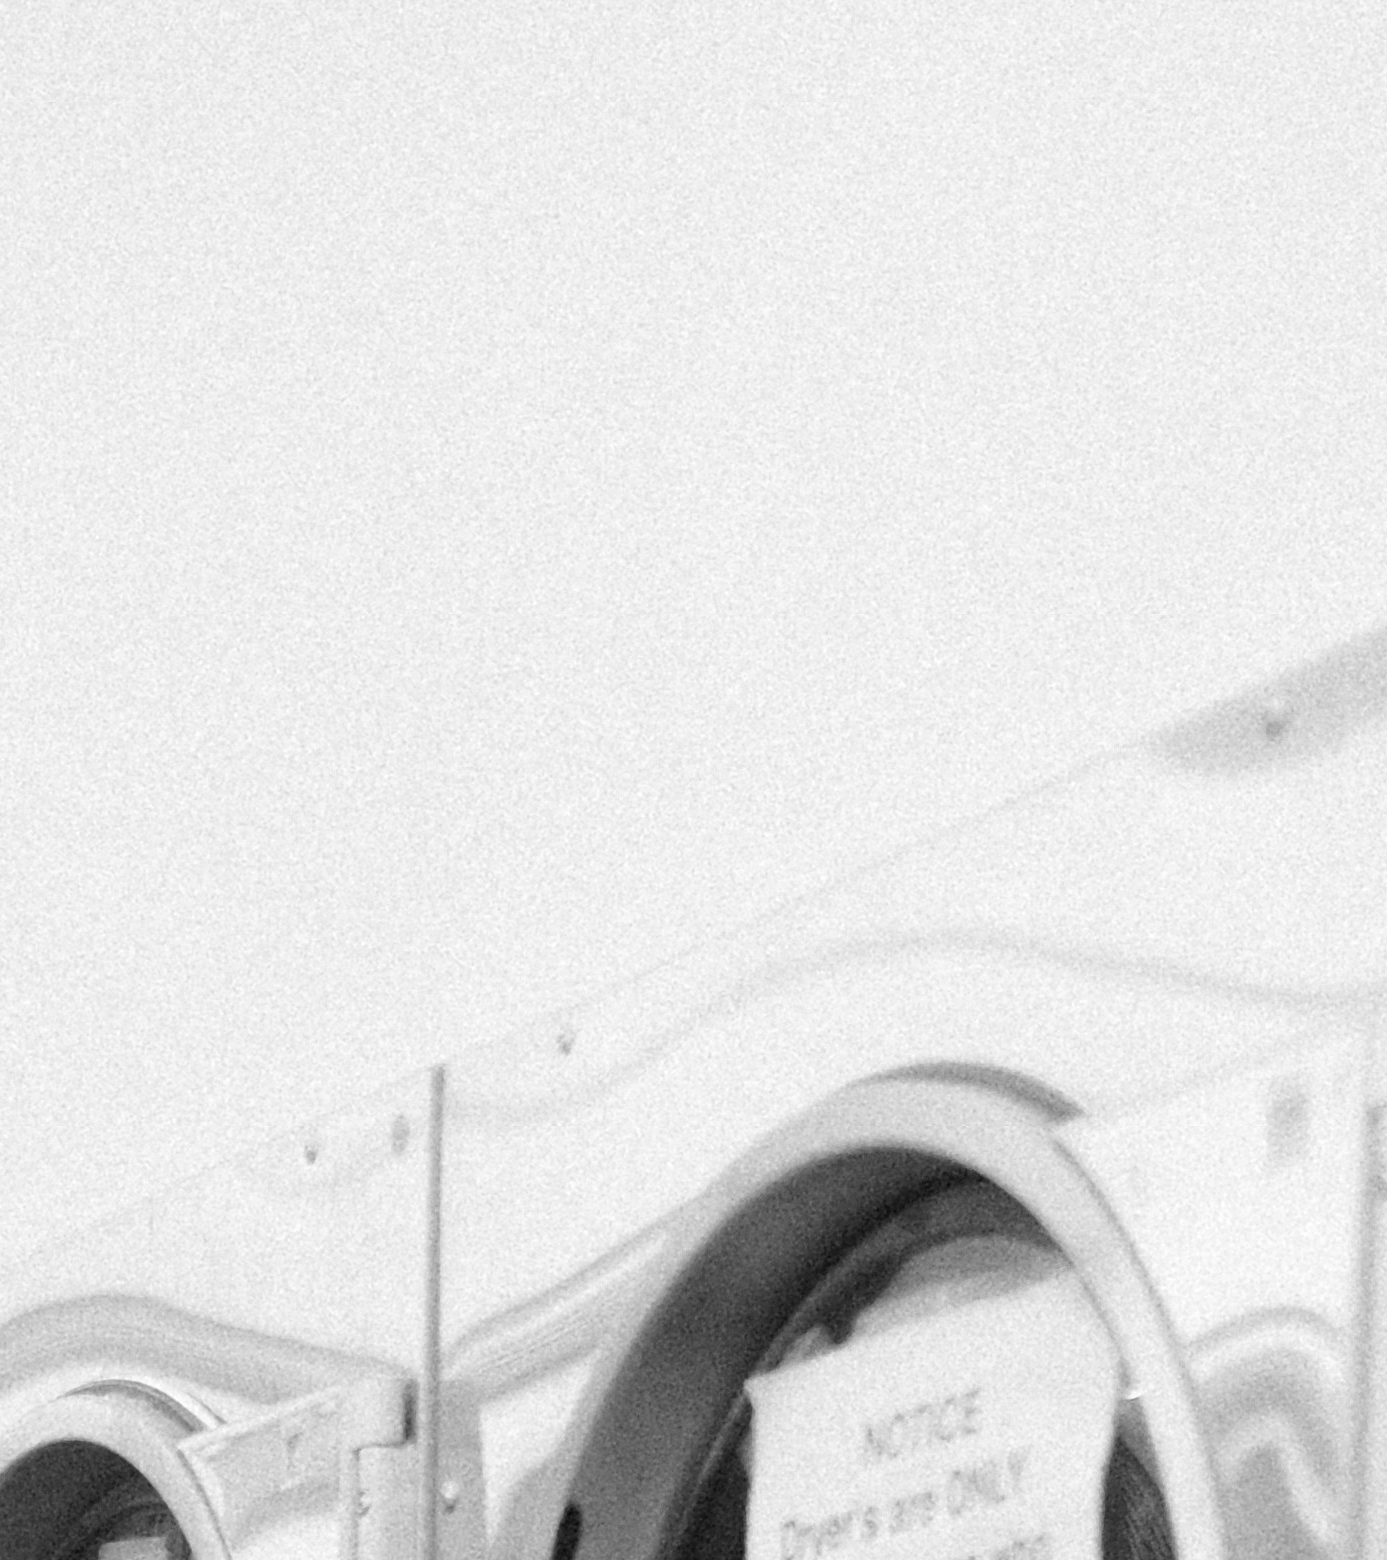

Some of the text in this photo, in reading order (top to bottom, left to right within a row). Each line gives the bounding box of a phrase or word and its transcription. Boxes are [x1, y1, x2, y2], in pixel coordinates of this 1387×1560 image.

[864, 1386, 982, 1464] NOTICE
[888, 1489, 936, 1535] are
[947, 1447, 1027, 1518] ONLY
